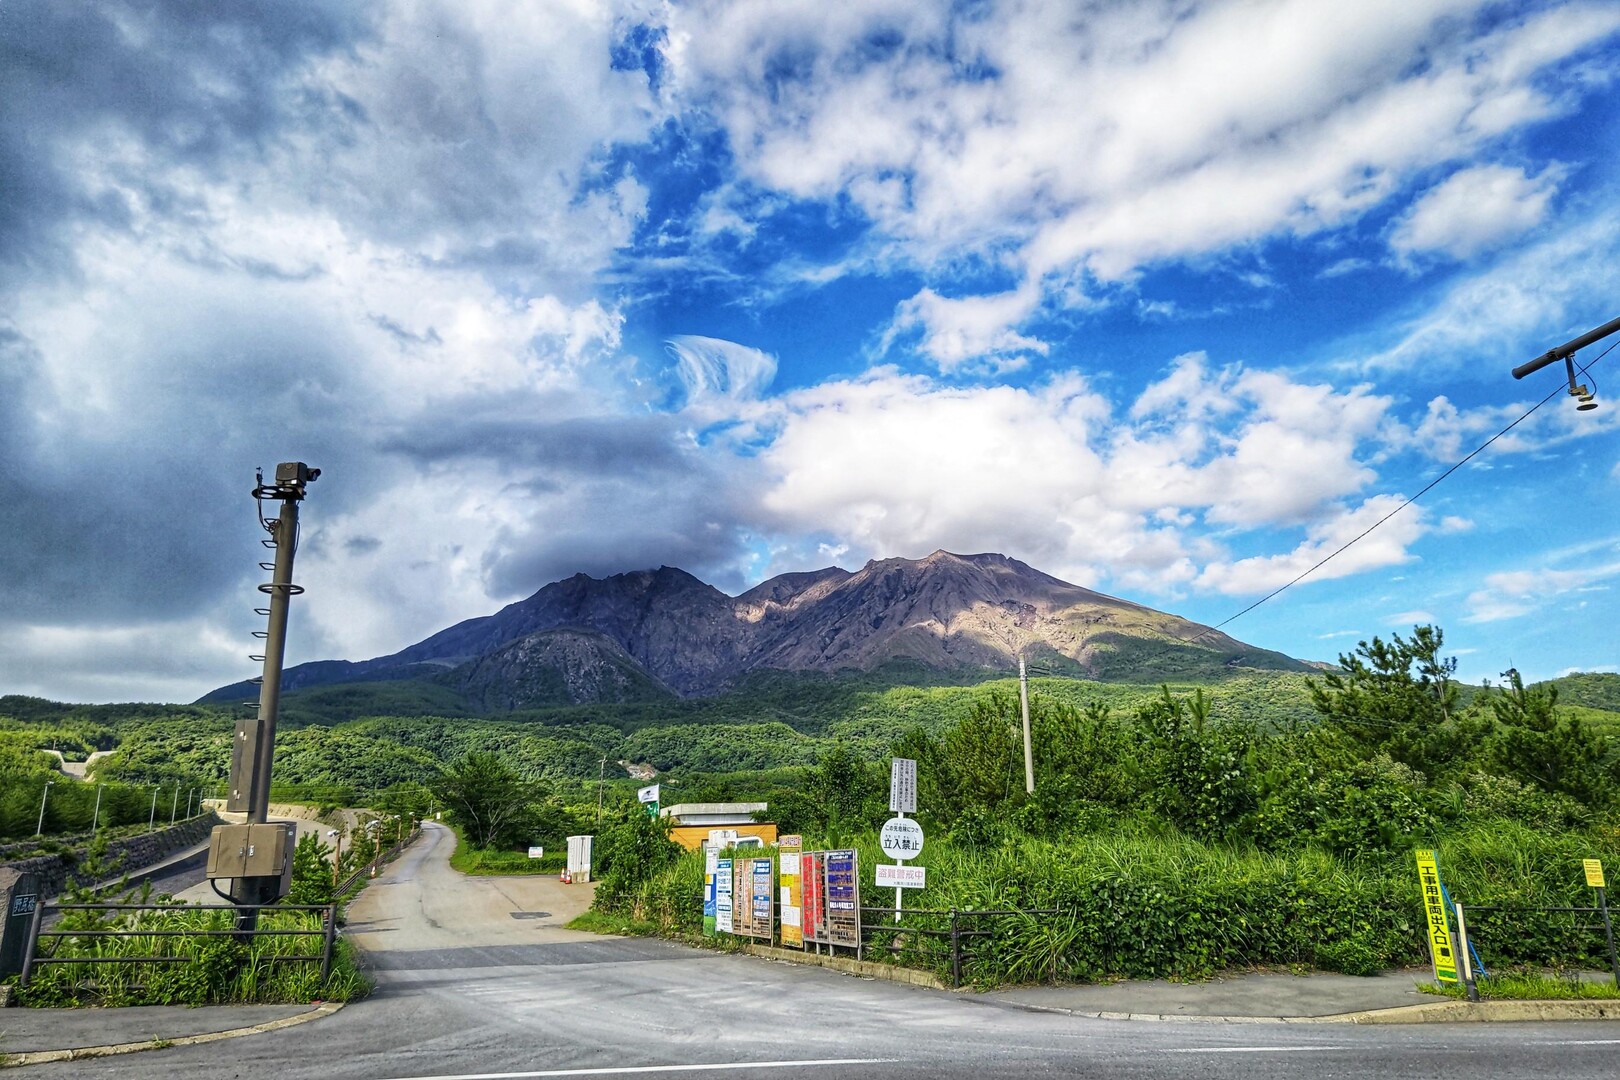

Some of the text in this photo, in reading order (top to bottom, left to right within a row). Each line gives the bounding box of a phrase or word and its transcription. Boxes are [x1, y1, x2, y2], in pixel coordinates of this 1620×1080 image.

[885, 825, 918, 833] この先危険につき
[883, 838, 920, 850] 立入禁止
[878, 868, 923, 879] 盗難警戒中
[1421, 866, 1448, 945] 工事用車両出入口
